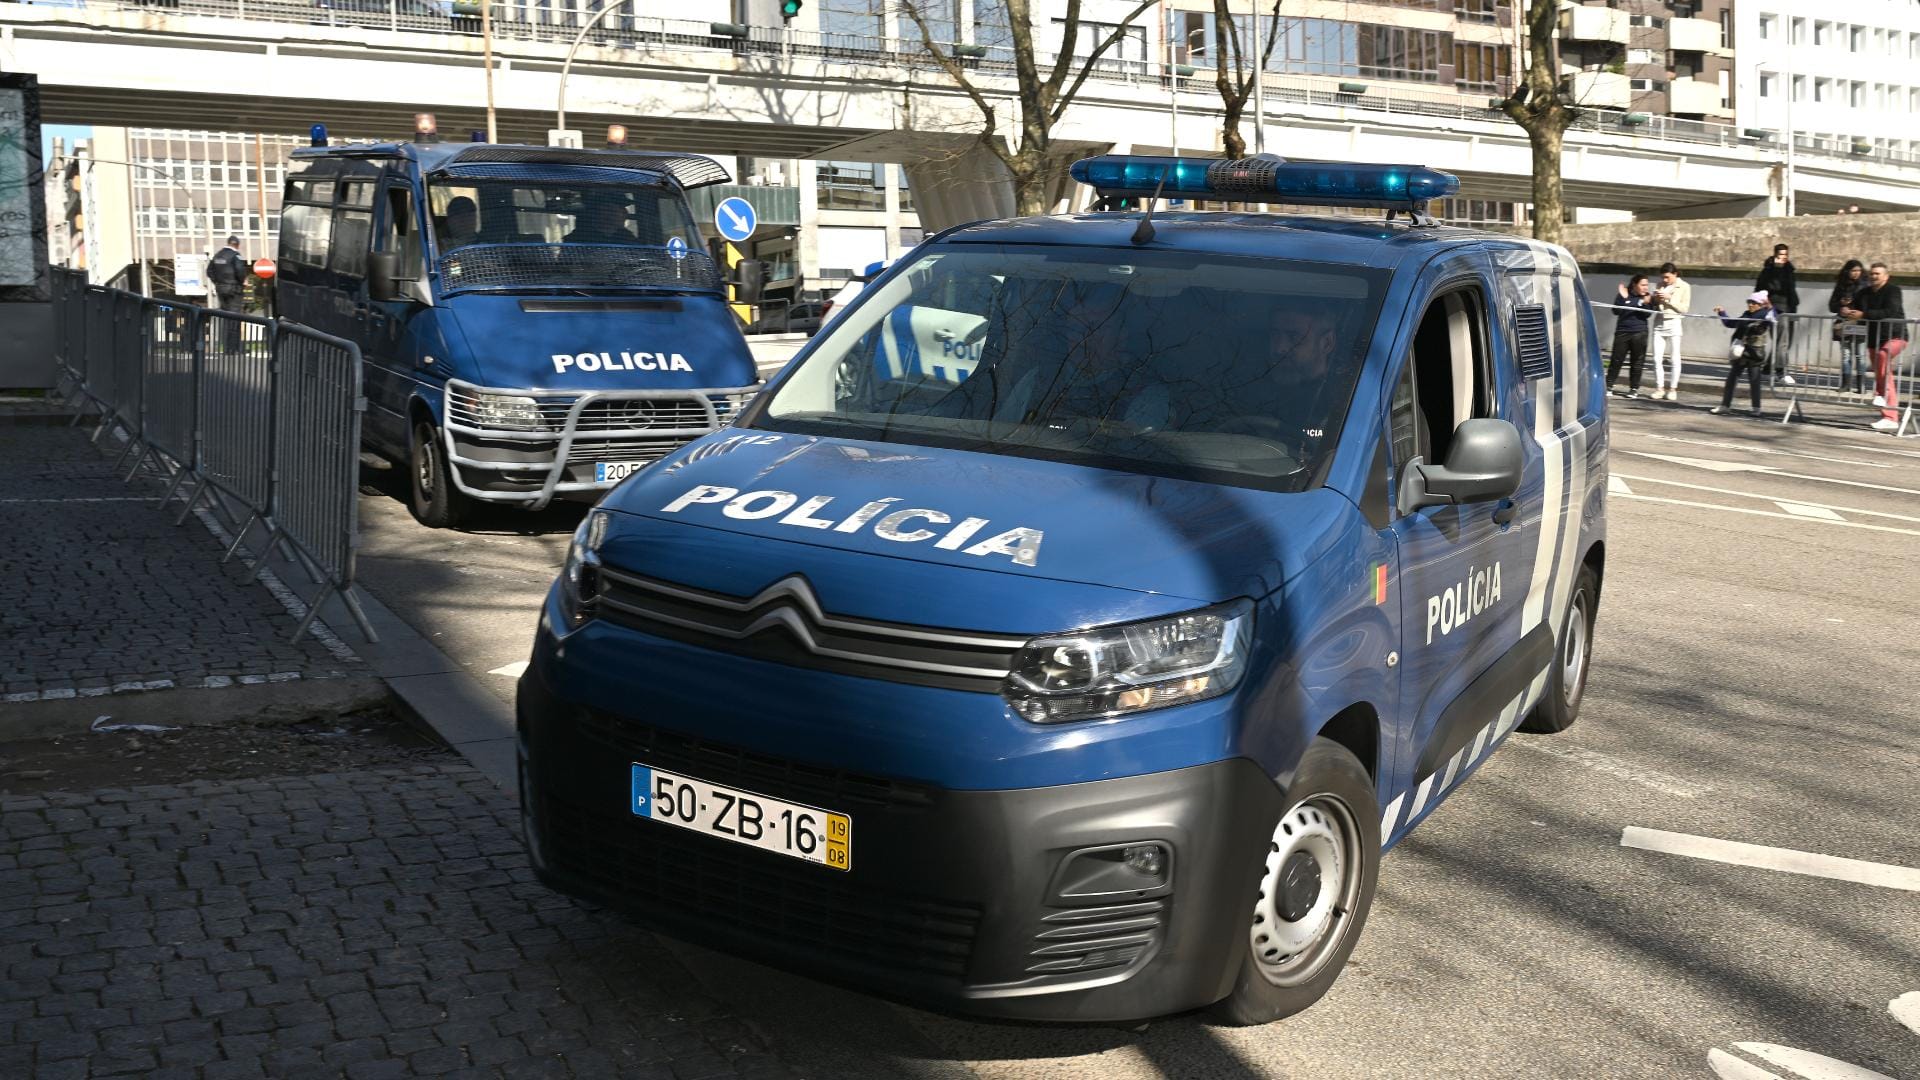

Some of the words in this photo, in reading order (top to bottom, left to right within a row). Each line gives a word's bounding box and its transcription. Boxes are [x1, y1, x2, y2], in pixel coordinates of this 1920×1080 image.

[660, 485, 1043, 567] POLÍCIA
[1426, 561, 1501, 646] POLÍCIA
[638, 796, 646, 806] P
[832, 820, 846, 836] 19
[829, 849, 845, 864] 08
